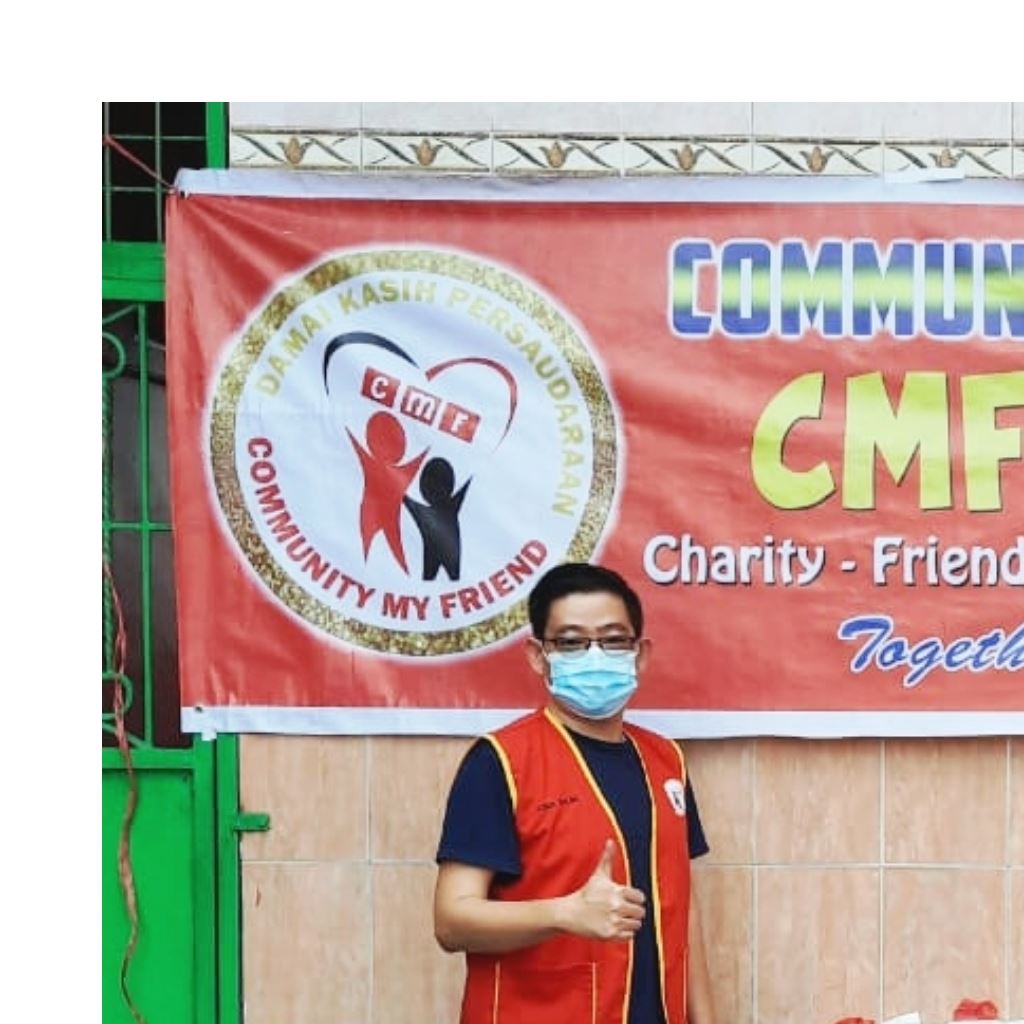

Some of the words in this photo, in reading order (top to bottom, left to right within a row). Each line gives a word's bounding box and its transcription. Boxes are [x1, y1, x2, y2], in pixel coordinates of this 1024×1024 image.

[256, 303, 334, 396] DAMAI
[338, 279, 437, 316] KASIH
[448, 287, 584, 518] PERSAUDARAAN
[247, 436, 376, 609] COMMUNITY
[381, 591, 430, 621] MY
[440, 539, 549, 620] FRIEND
[643, 535, 826, 586] Charity
